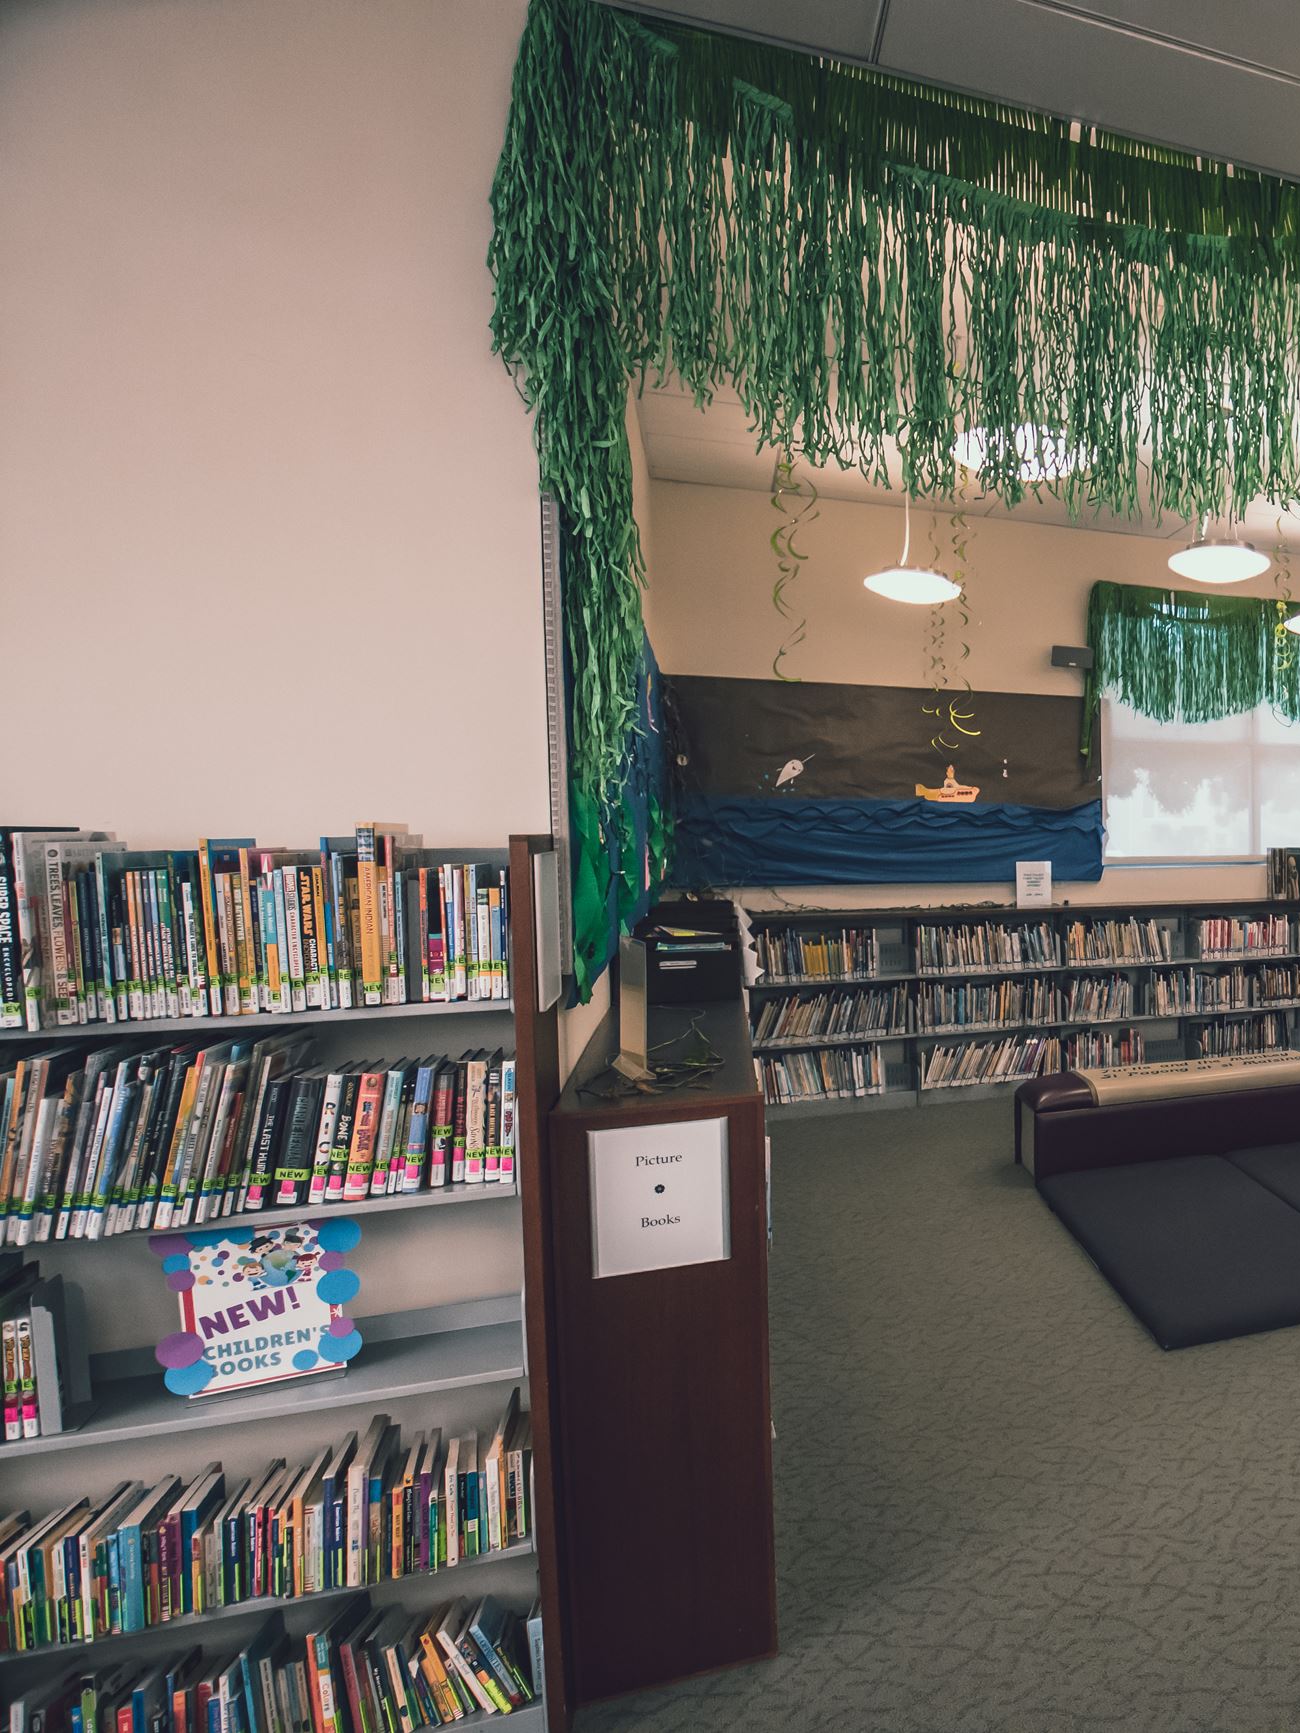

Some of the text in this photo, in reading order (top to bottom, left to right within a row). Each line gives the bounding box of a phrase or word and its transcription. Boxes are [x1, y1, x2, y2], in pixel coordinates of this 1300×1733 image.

[364, 867, 372, 906] AMERICAN
[300, 872, 313, 936] STAR WARS
[0, 910, 13, 944] SPACE
[289, 911, 297, 941] CHARACTER
[365, 908, 374, 935] INDIAN
[52, 930, 67, 972] FLOWERS
[291, 942, 300, 977] ENCYCLOPEDIA
[5, 947, 14, 1002] ENCYCLOPEDI
[1230, 1051, 1289, 1061] Monkey
[261, 1129, 272, 1150] LAST
[337, 1115, 352, 1141] BONE
[432, 1127, 452, 1136] NEW
[280, 1170, 304, 1179] NEW
[349, 1164, 371, 1172] NEW
[635, 1153, 683, 1167] Picture
[640, 1212, 681, 1229] Books
[199, 1286, 301, 1340] NEW!
[203, 1324, 331, 1361] CHILDREN'S
[321, 1682, 331, 1712] Colors
